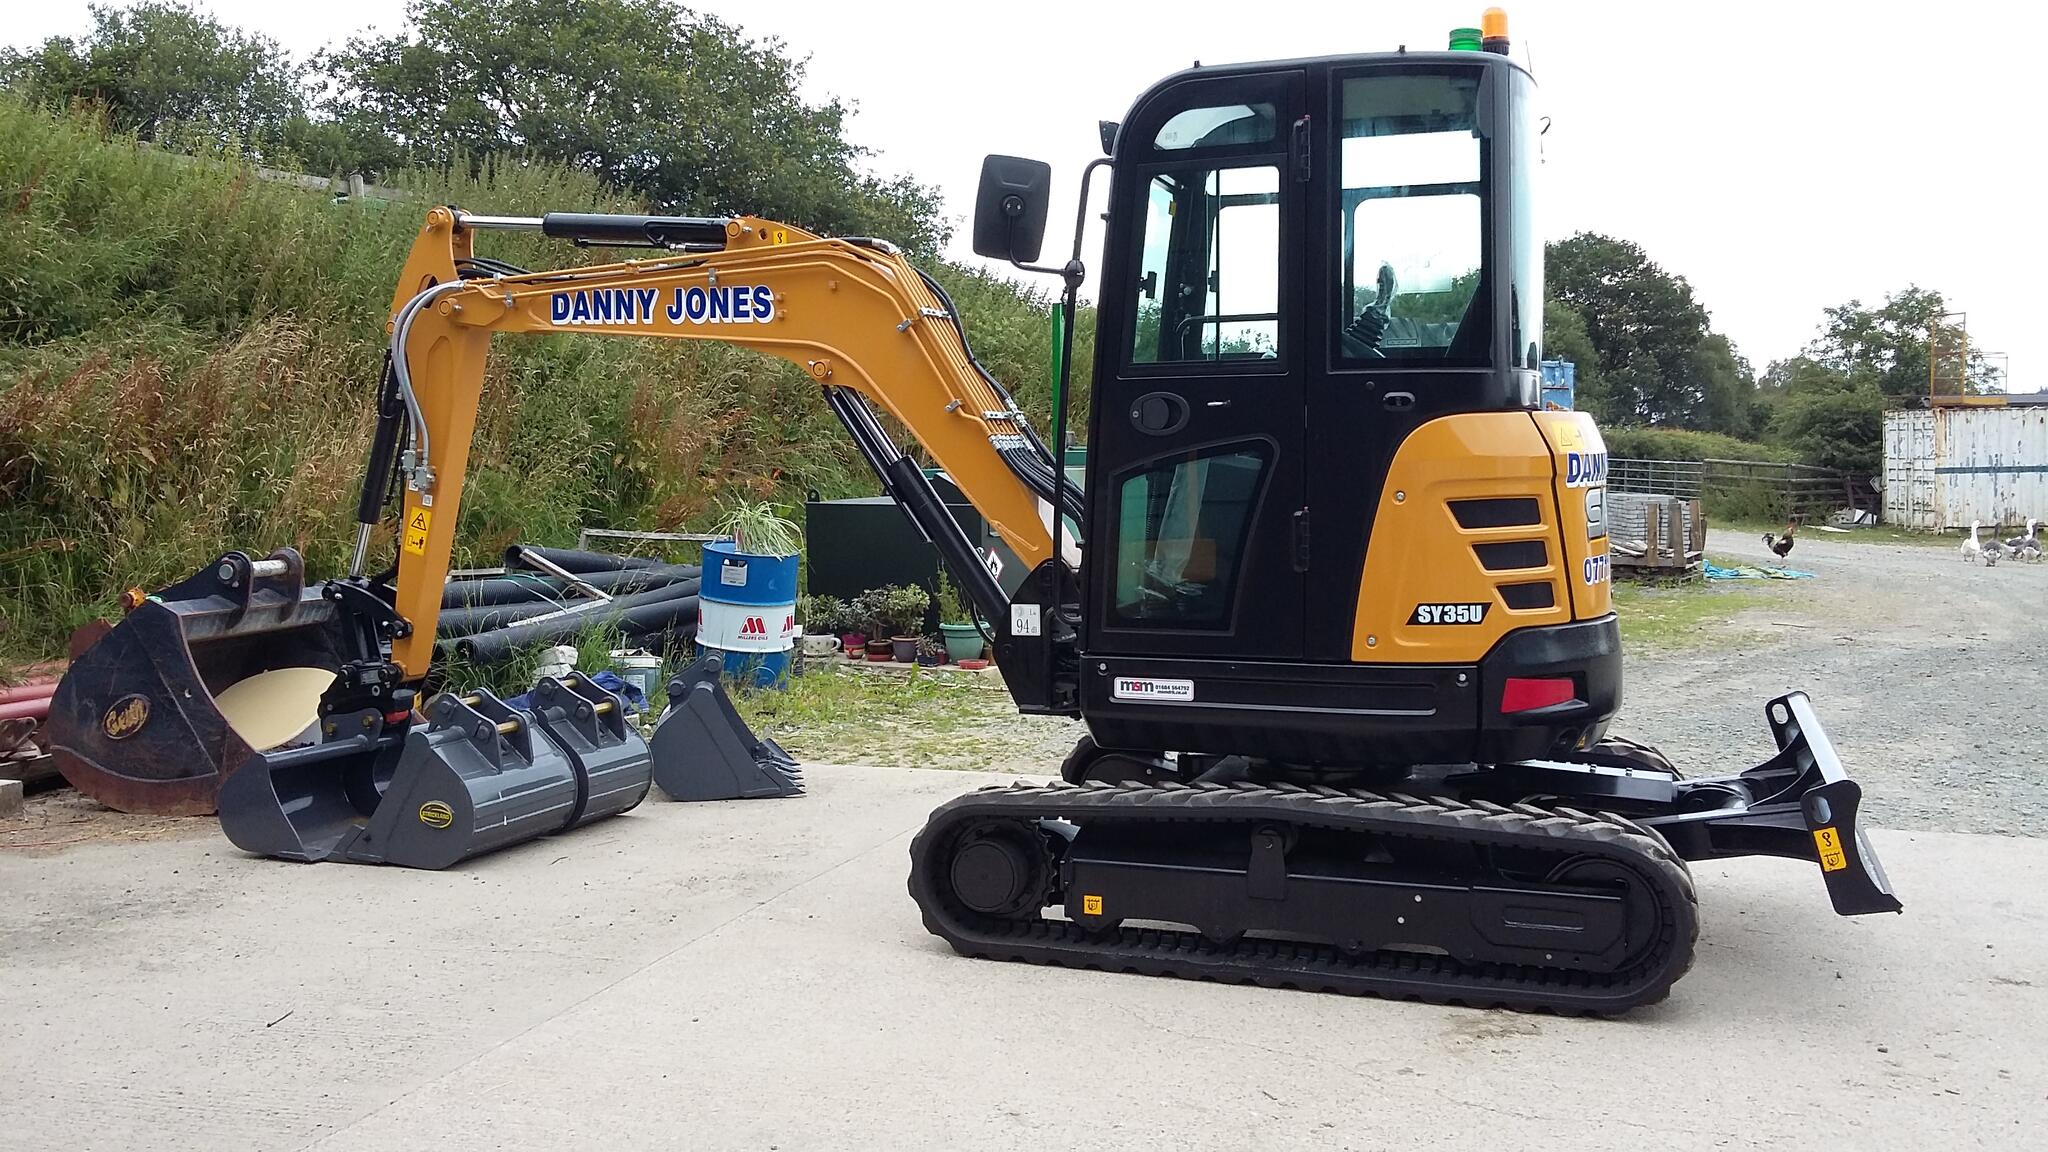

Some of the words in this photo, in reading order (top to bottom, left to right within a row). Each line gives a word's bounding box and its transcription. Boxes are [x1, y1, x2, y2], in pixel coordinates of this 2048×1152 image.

[551, 288, 659, 325] DANNY
[666, 285, 775, 324] JONES
[1417, 605, 1483, 623] SY35U
[1016, 618, 1029, 634] 94
[1120, 681, 1154, 692] msm
